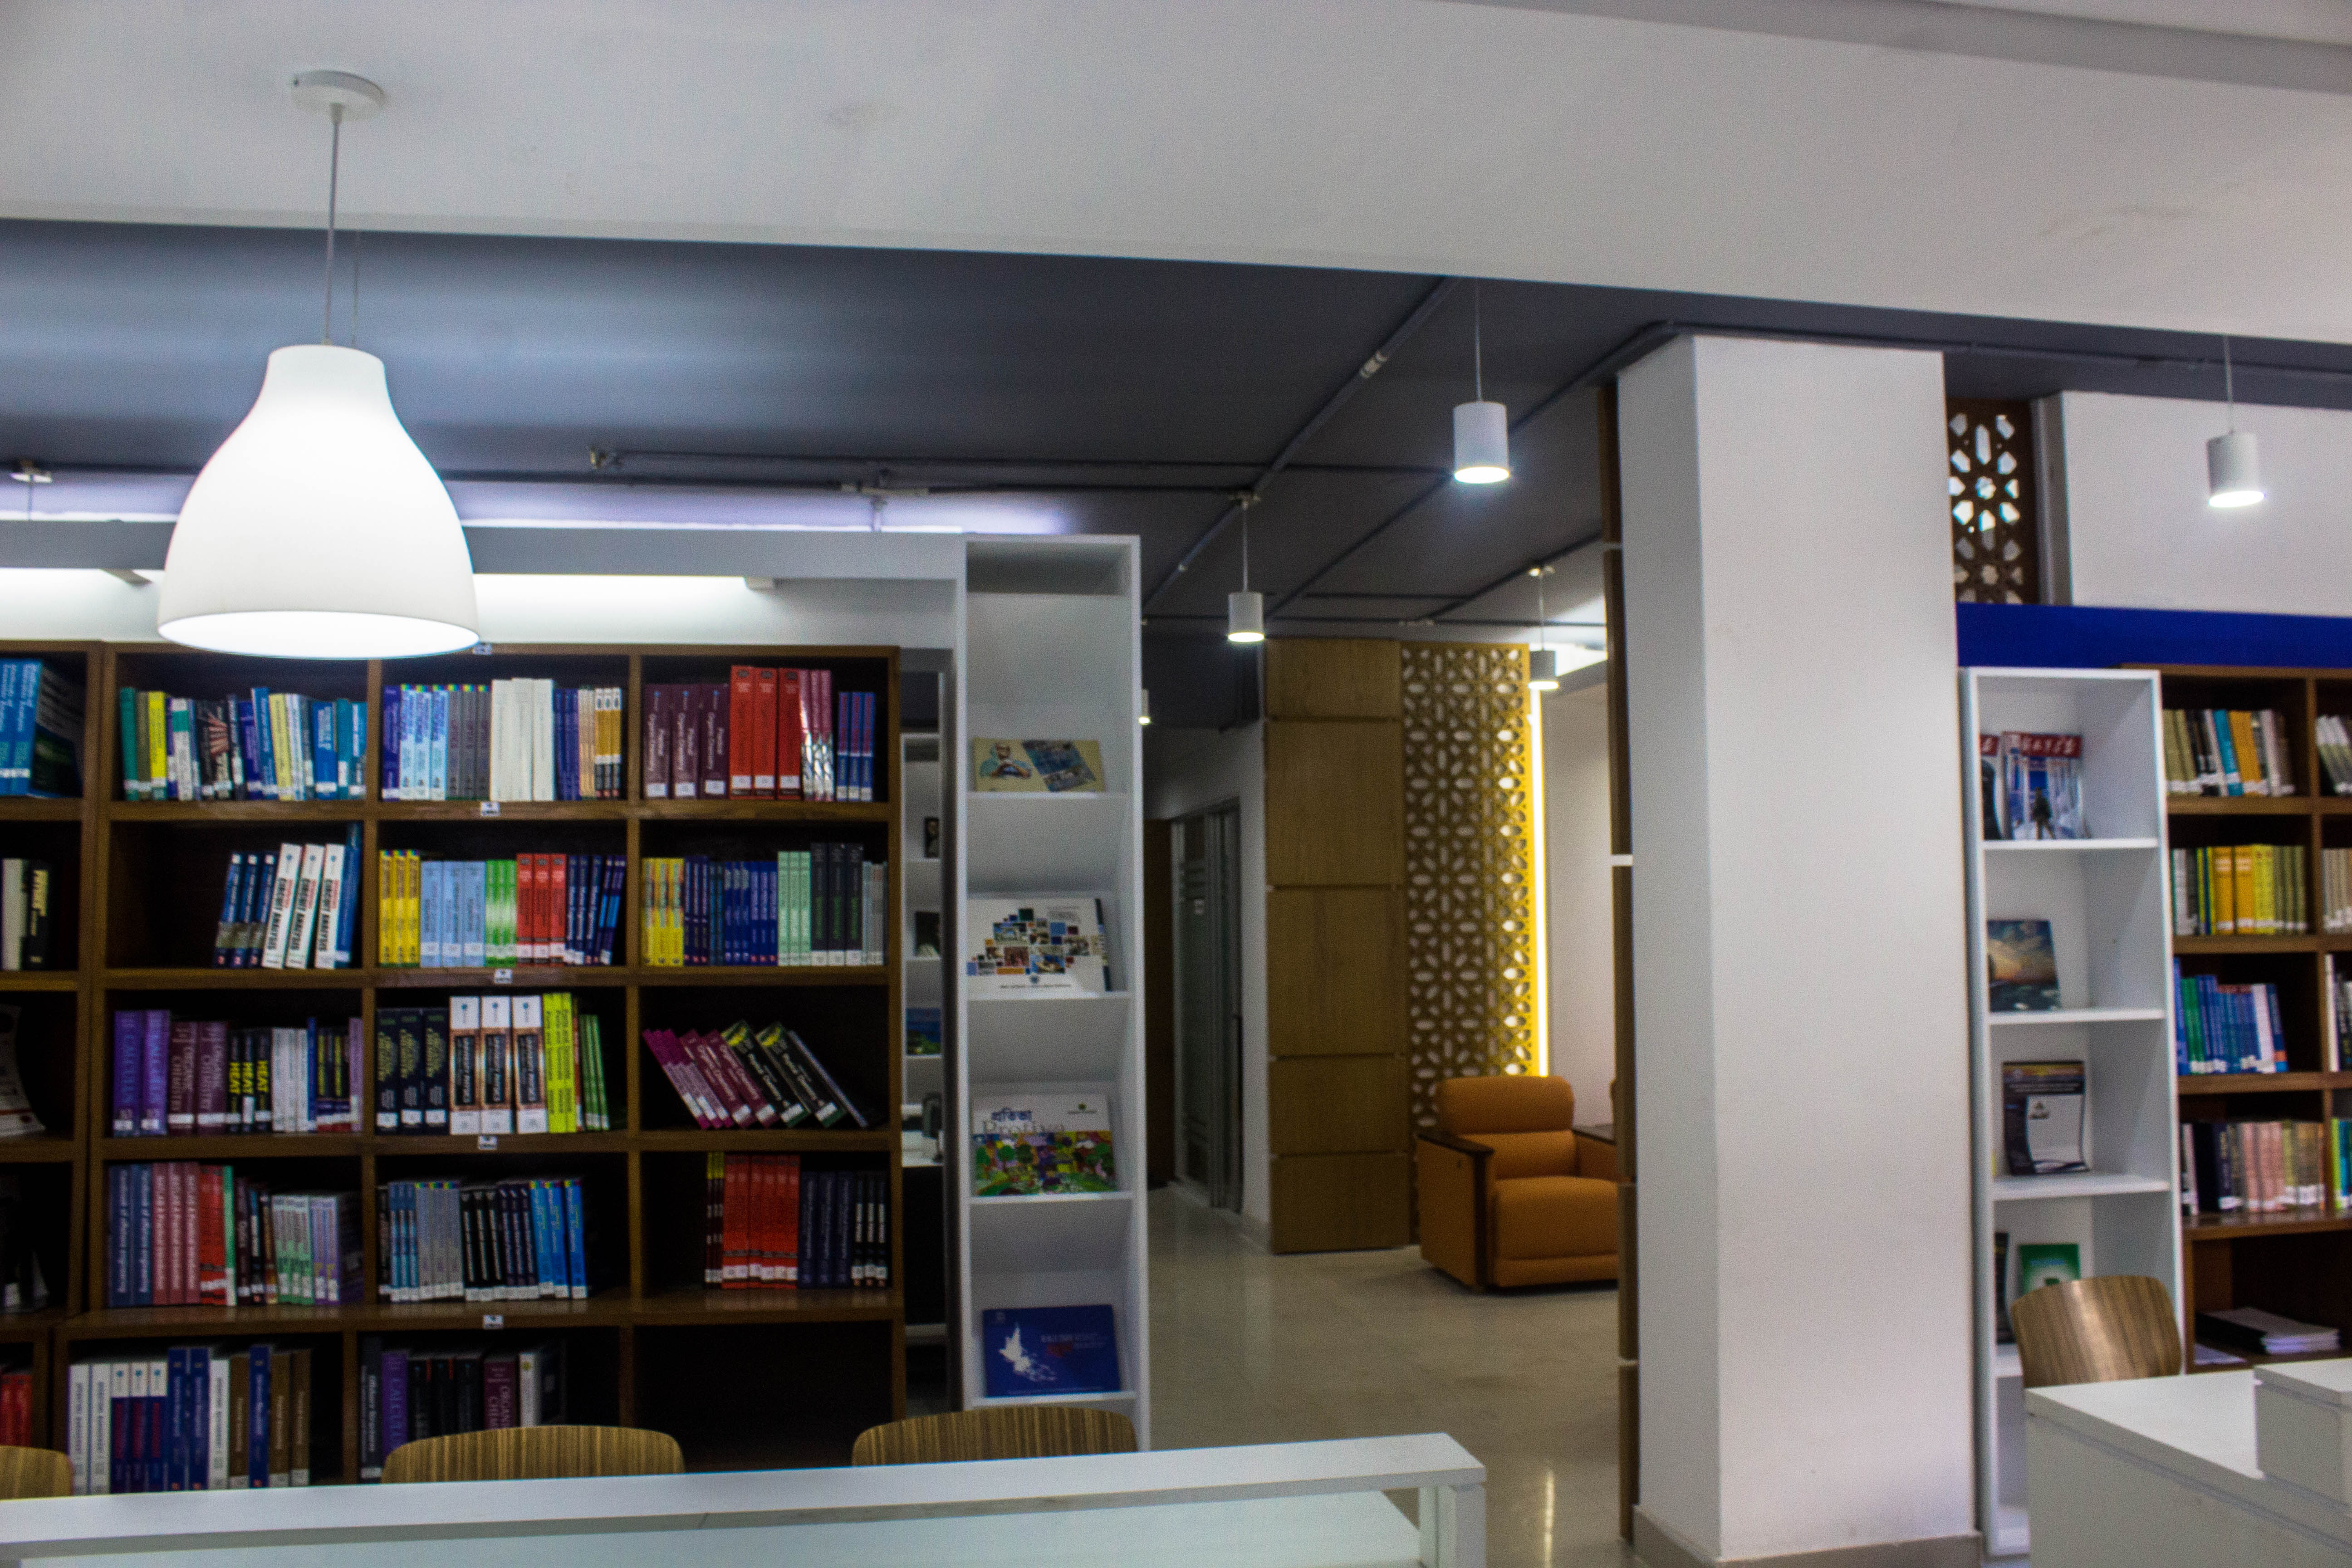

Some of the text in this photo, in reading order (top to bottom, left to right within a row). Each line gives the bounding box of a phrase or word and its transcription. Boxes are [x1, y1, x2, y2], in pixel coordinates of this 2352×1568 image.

[229, 1062, 241, 1095] HEAT
[242, 1062, 255, 1095] HEAT
[256, 1060, 268, 1093] HEAT
